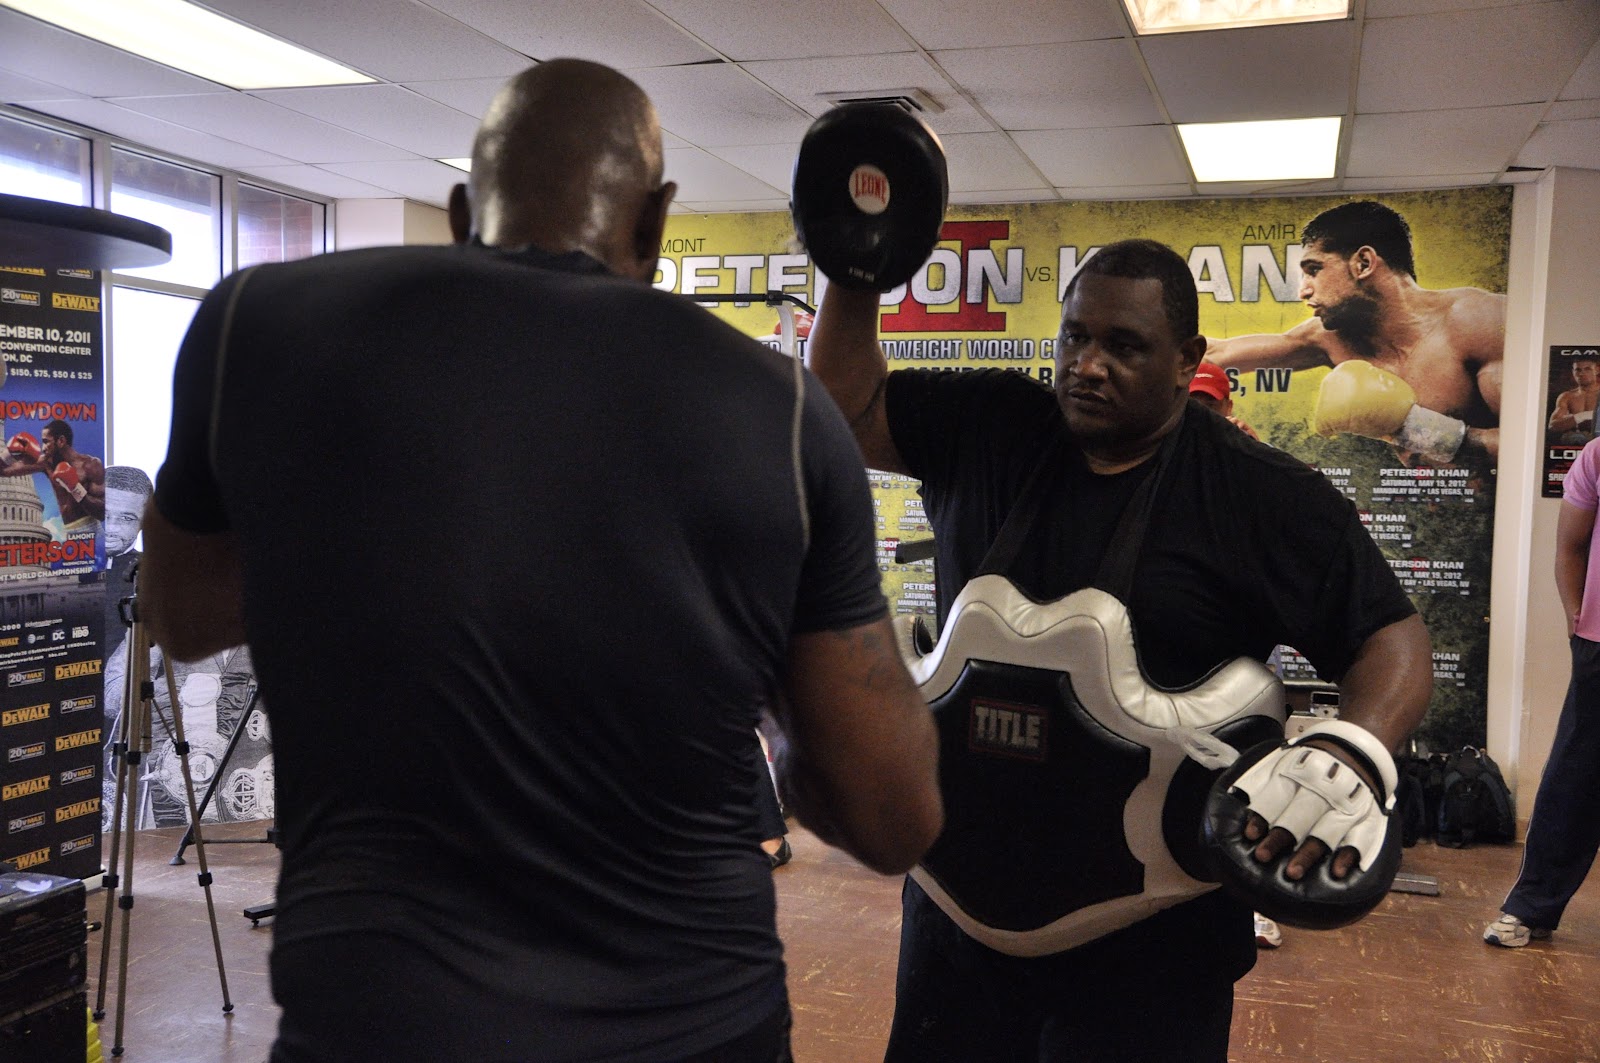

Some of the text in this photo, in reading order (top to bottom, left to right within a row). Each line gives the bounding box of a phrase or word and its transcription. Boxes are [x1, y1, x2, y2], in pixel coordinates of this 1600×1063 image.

[1242, 224, 1296, 240] AMIR
[1025, 266, 1055, 282] VS.
[46, 328, 63, 343] 10,
[66, 331, 91, 344] 2011
[0, 342, 91, 356] CONVENTION CENTER
[967, 339, 1035, 360] WORLD
[20, 354, 33, 363] DC
[34, 370, 51, 379] $75,
[53, 371, 68, 379] $50
[70, 371, 76, 379] &
[78, 372, 93, 380] $25
[1256, 369, 1291, 393] NV
[1550, 450, 1583, 460] LO
[1380, 468, 1469, 477] PETERSON KHAN
[1448, 480, 1467, 488] 2012
[1376, 514, 1406, 522] KHAN
[68, 531, 95, 540] LAMONT
[10, 571, 36, 580] WORLD
[37, 567, 93, 578] CHAMPIONSHIP
[52, 631, 66, 641] DC
[72, 629, 89, 639] HBO
[974, 706, 1041, 748] TITLE
